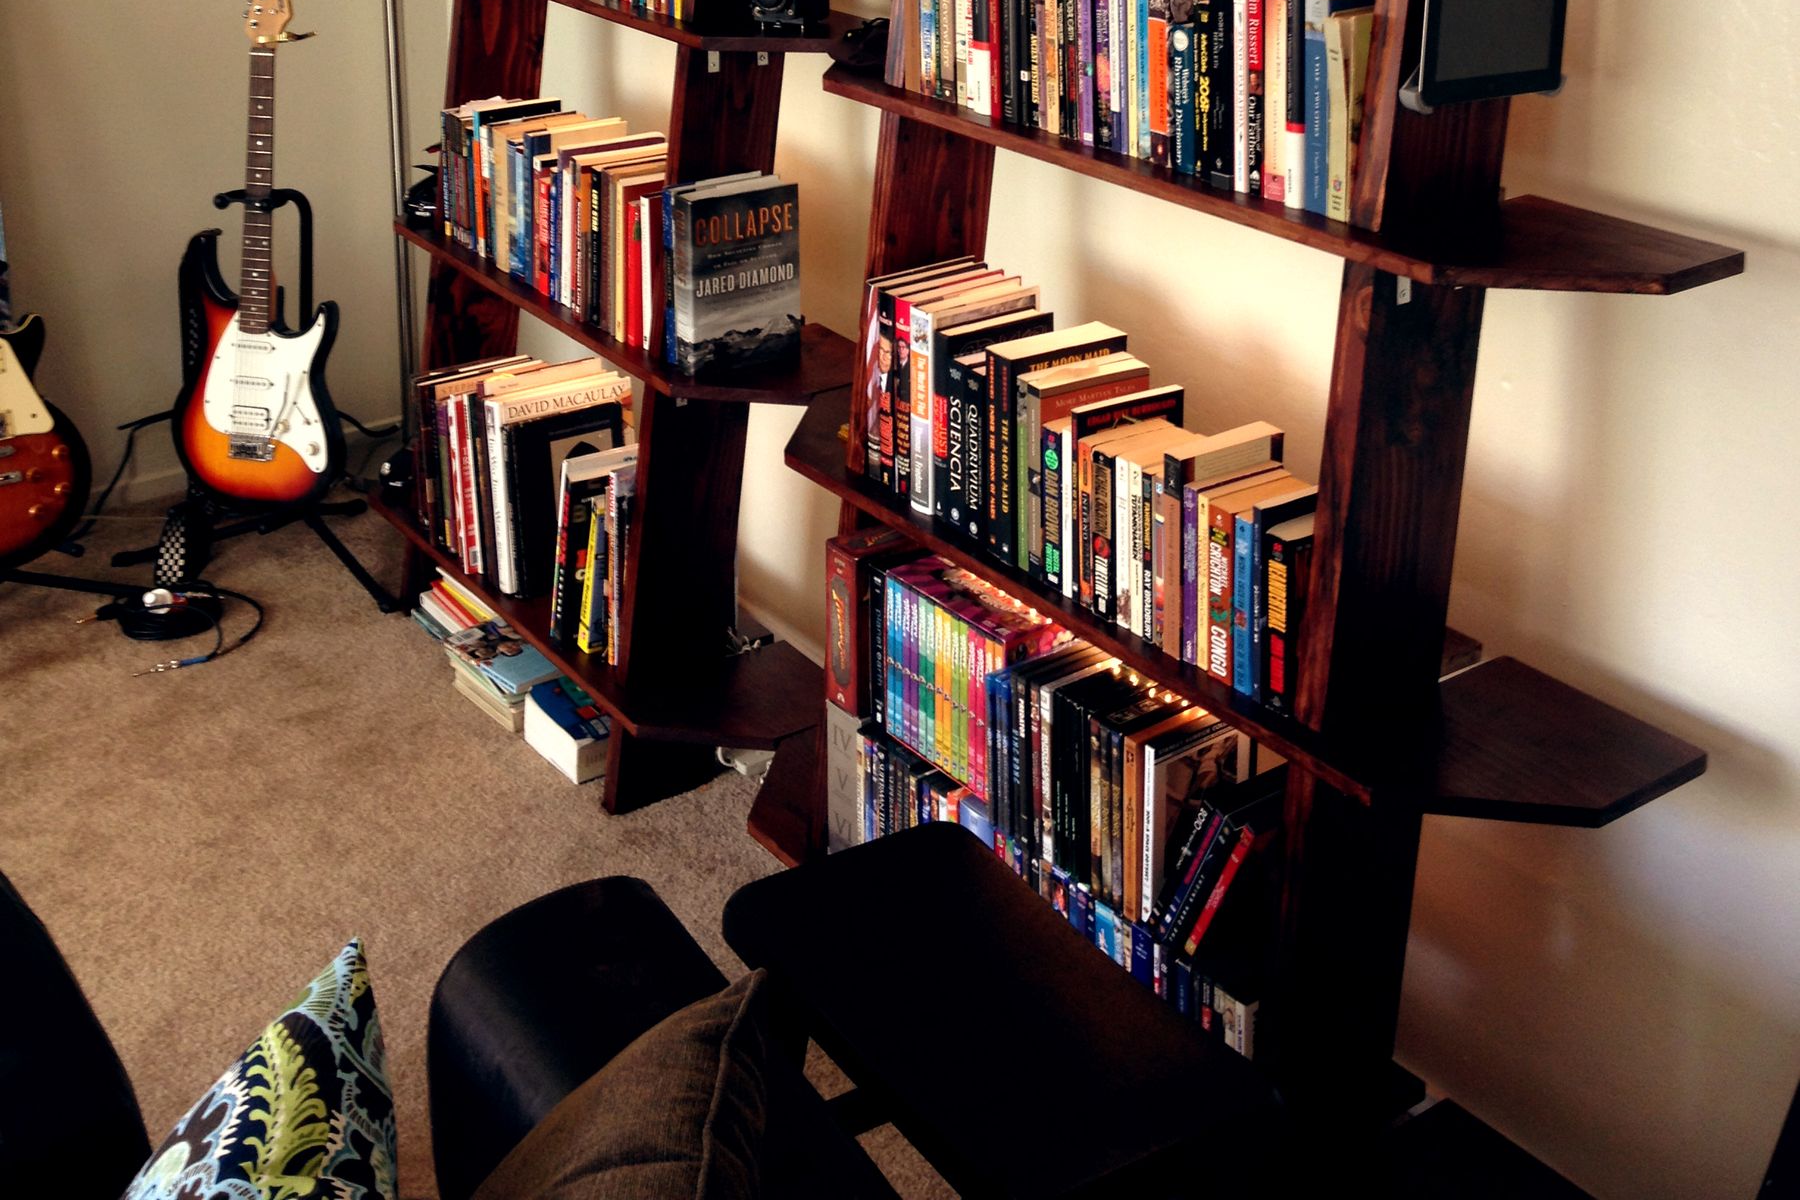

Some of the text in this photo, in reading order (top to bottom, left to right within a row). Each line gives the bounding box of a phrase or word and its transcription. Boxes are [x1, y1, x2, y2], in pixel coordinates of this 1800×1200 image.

[1248, 17, 1259, 64] Russert
[1174, 56, 1184, 167] Rhyming Dictionary
[1181, 68, 1190, 104] Webster's
[1248, 95, 1258, 166] Our Fathers
[694, 202, 793, 247] COLLAPSE
[696, 263, 794, 298] JARED DIAMOND
[507, 383, 627, 419] DAVID MACAULAY
[949, 395, 961, 492] SCIENCIA
[967, 404, 978, 510] QUADRIVIUM
[1001, 418, 1009, 514] THE MOON MAID
[1045, 469, 1059, 544] DAN BROWN
[1143, 501, 1151, 550] FAHRENHEIT
[1094, 555, 1108, 599] TIMELINE
[1209, 541, 1223, 596] CRICHTON
[1144, 590, 1152, 639] BRADBURY
[873, 608, 884, 687] planet earth
[1211, 625, 1227, 677] CONGO
